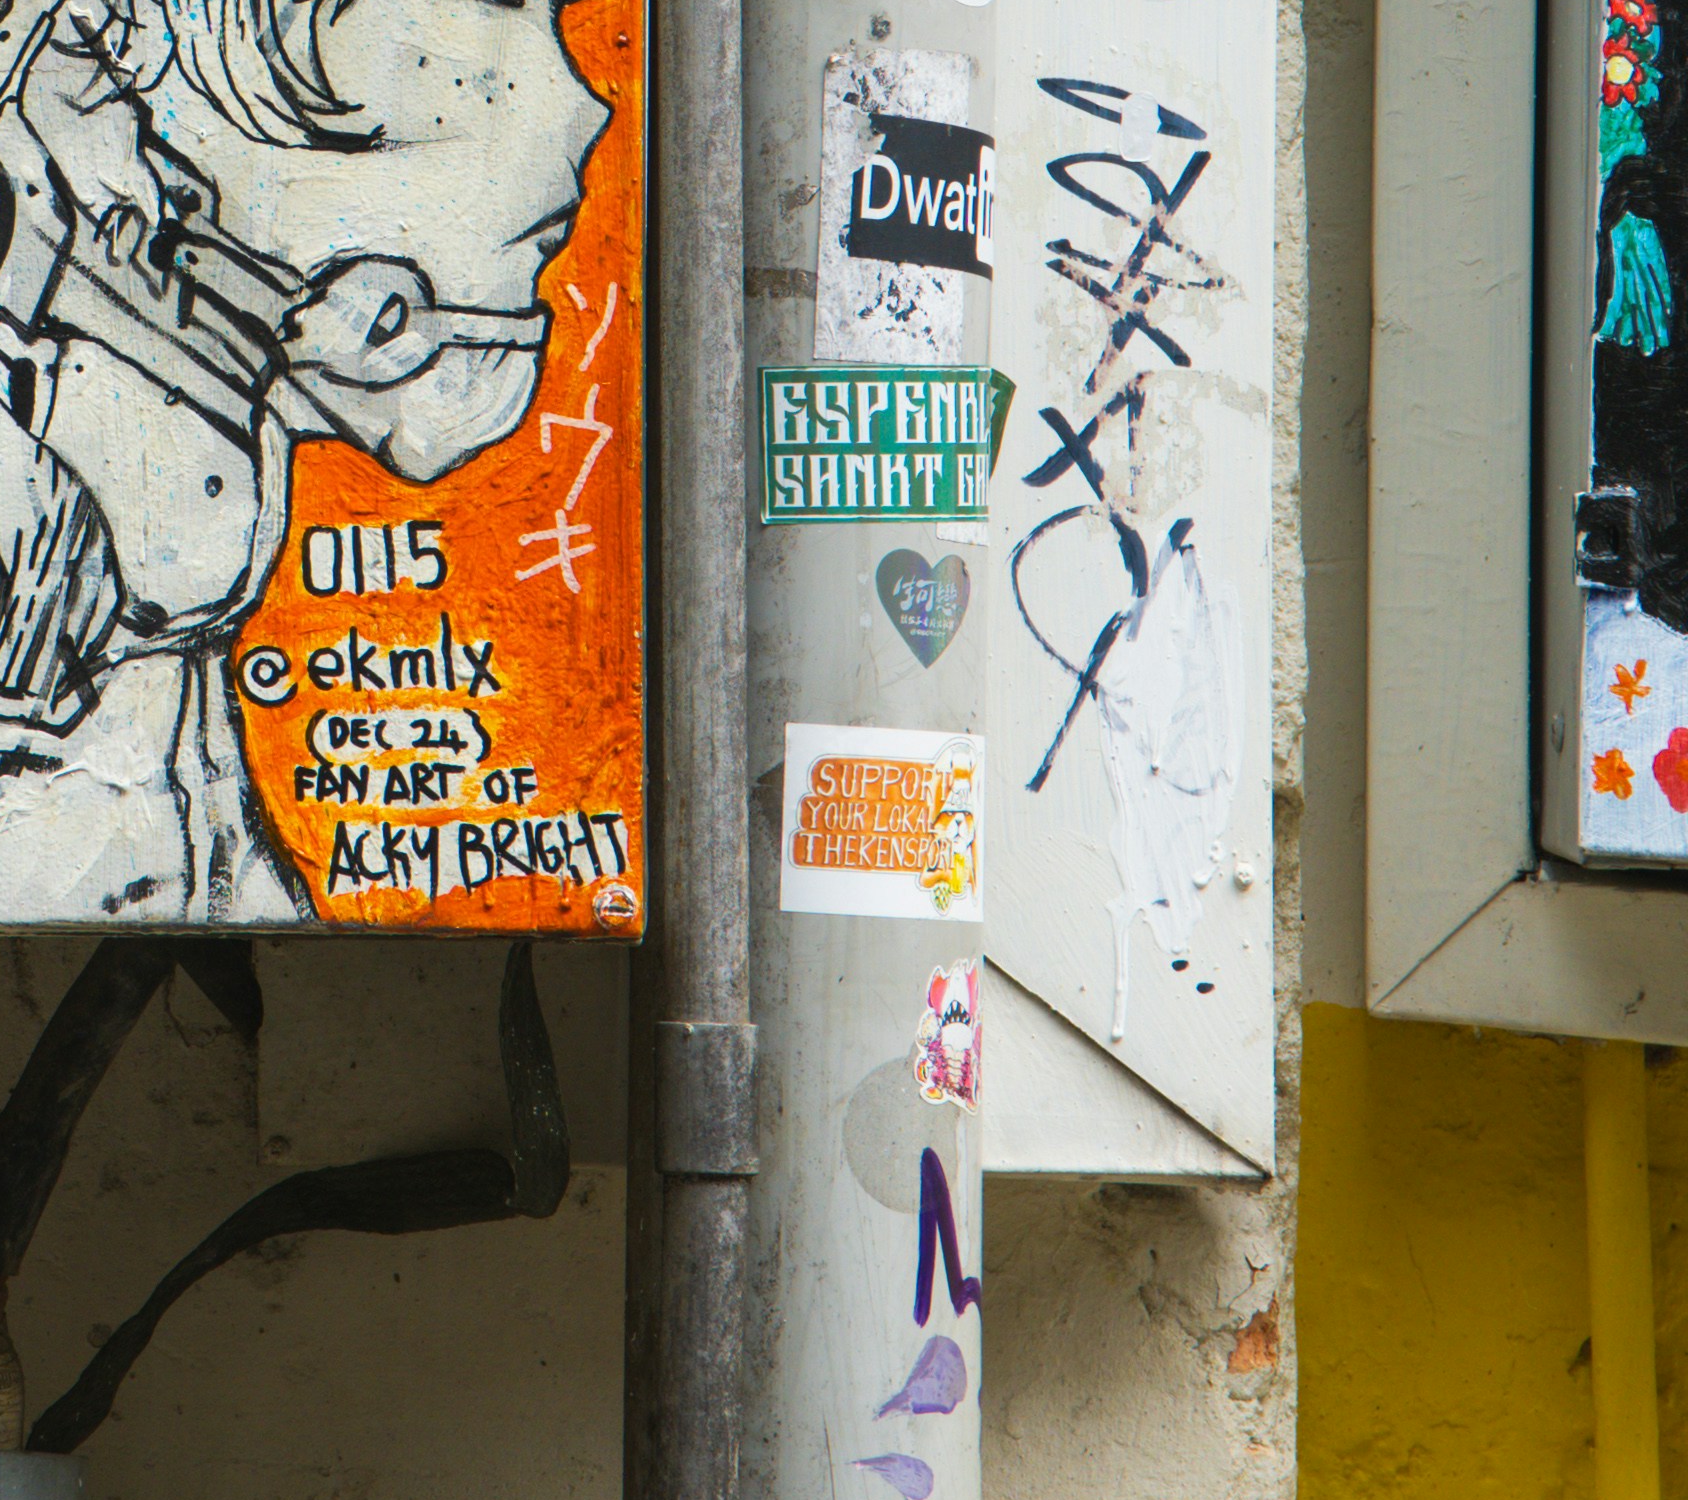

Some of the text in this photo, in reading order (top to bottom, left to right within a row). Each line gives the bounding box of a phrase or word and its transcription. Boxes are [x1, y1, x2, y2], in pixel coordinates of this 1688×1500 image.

[773, 453, 945, 508] SANKT
[293, 764, 538, 804] FAN ART OF
[816, 763, 952, 801] SUPPORT
[807, 801, 941, 834] YOUR LOKAL
[328, 811, 628, 901] ACKY BRIGHT
